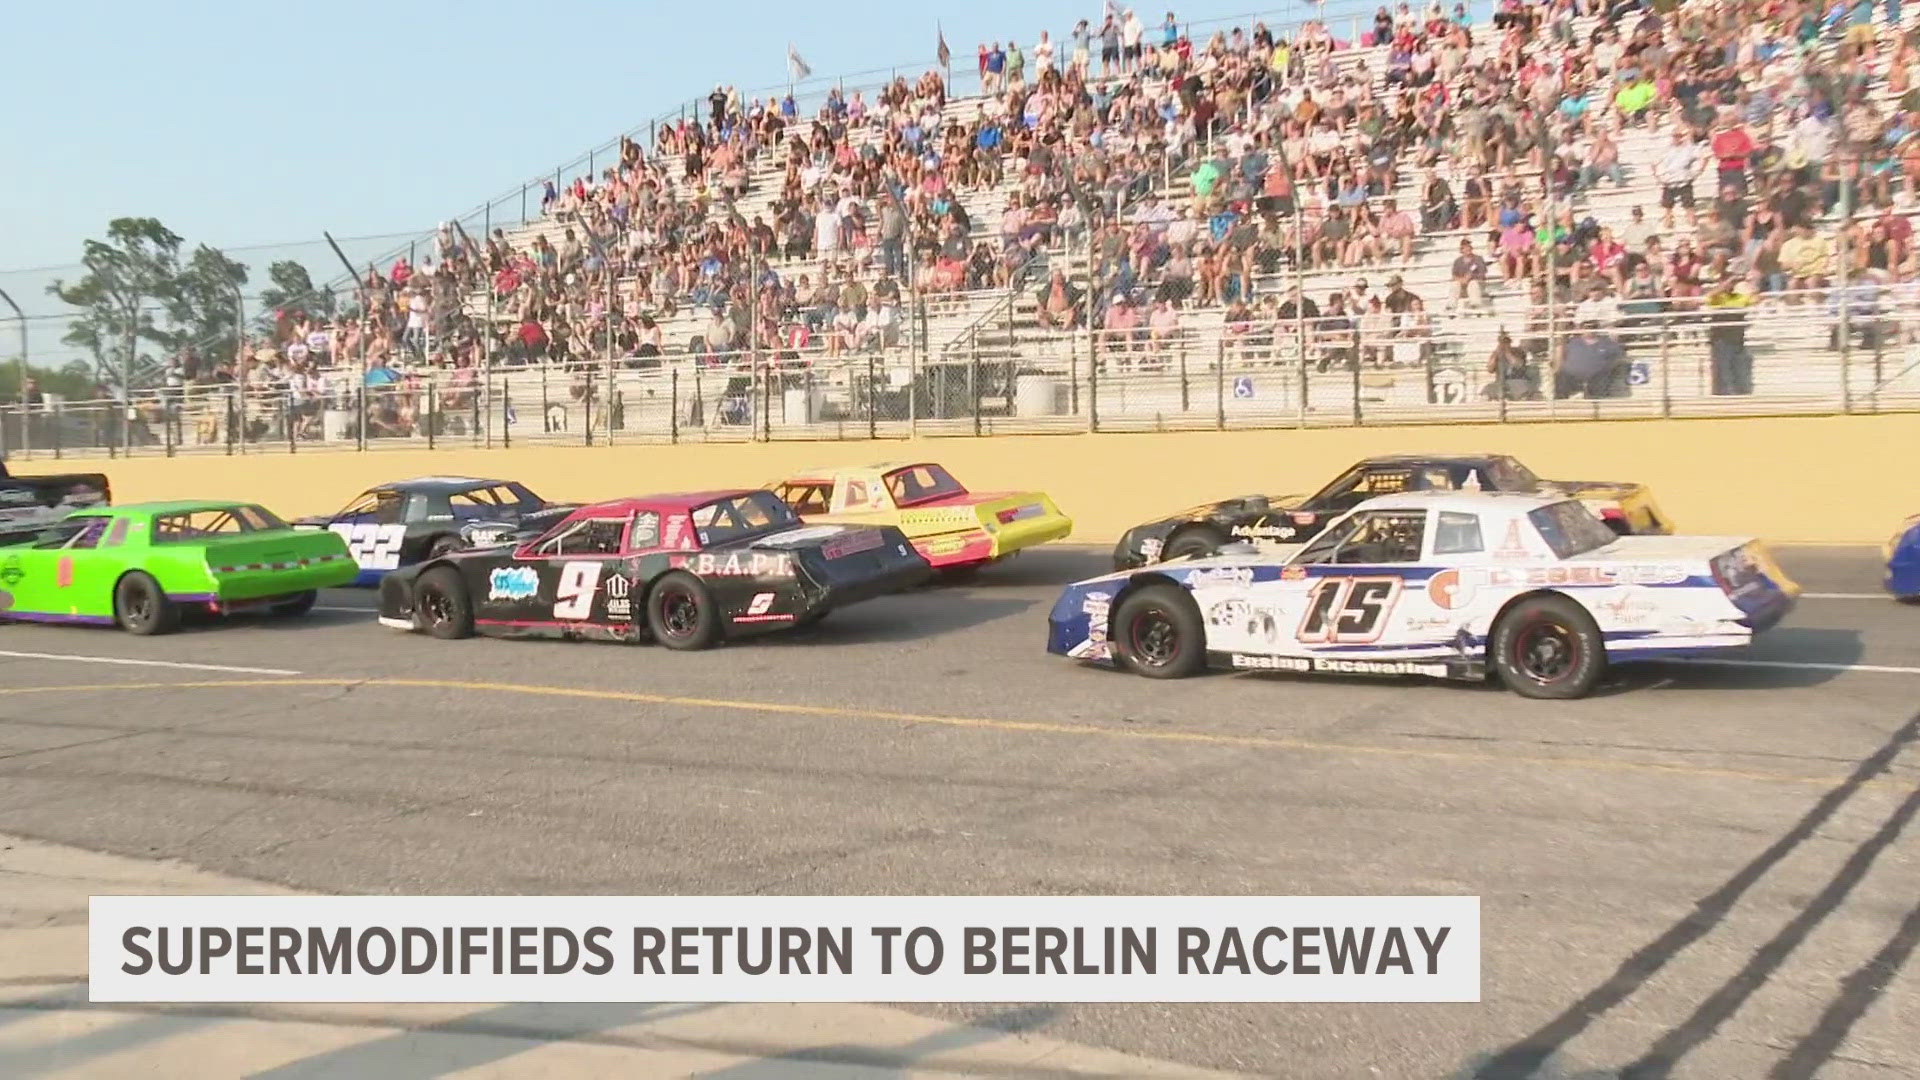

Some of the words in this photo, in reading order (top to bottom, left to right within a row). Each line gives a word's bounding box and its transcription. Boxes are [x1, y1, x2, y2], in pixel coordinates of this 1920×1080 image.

[1231, 516, 1296, 540] Advantage
[552, 560, 603, 620] 9
[1296, 575, 1404, 643] 15
